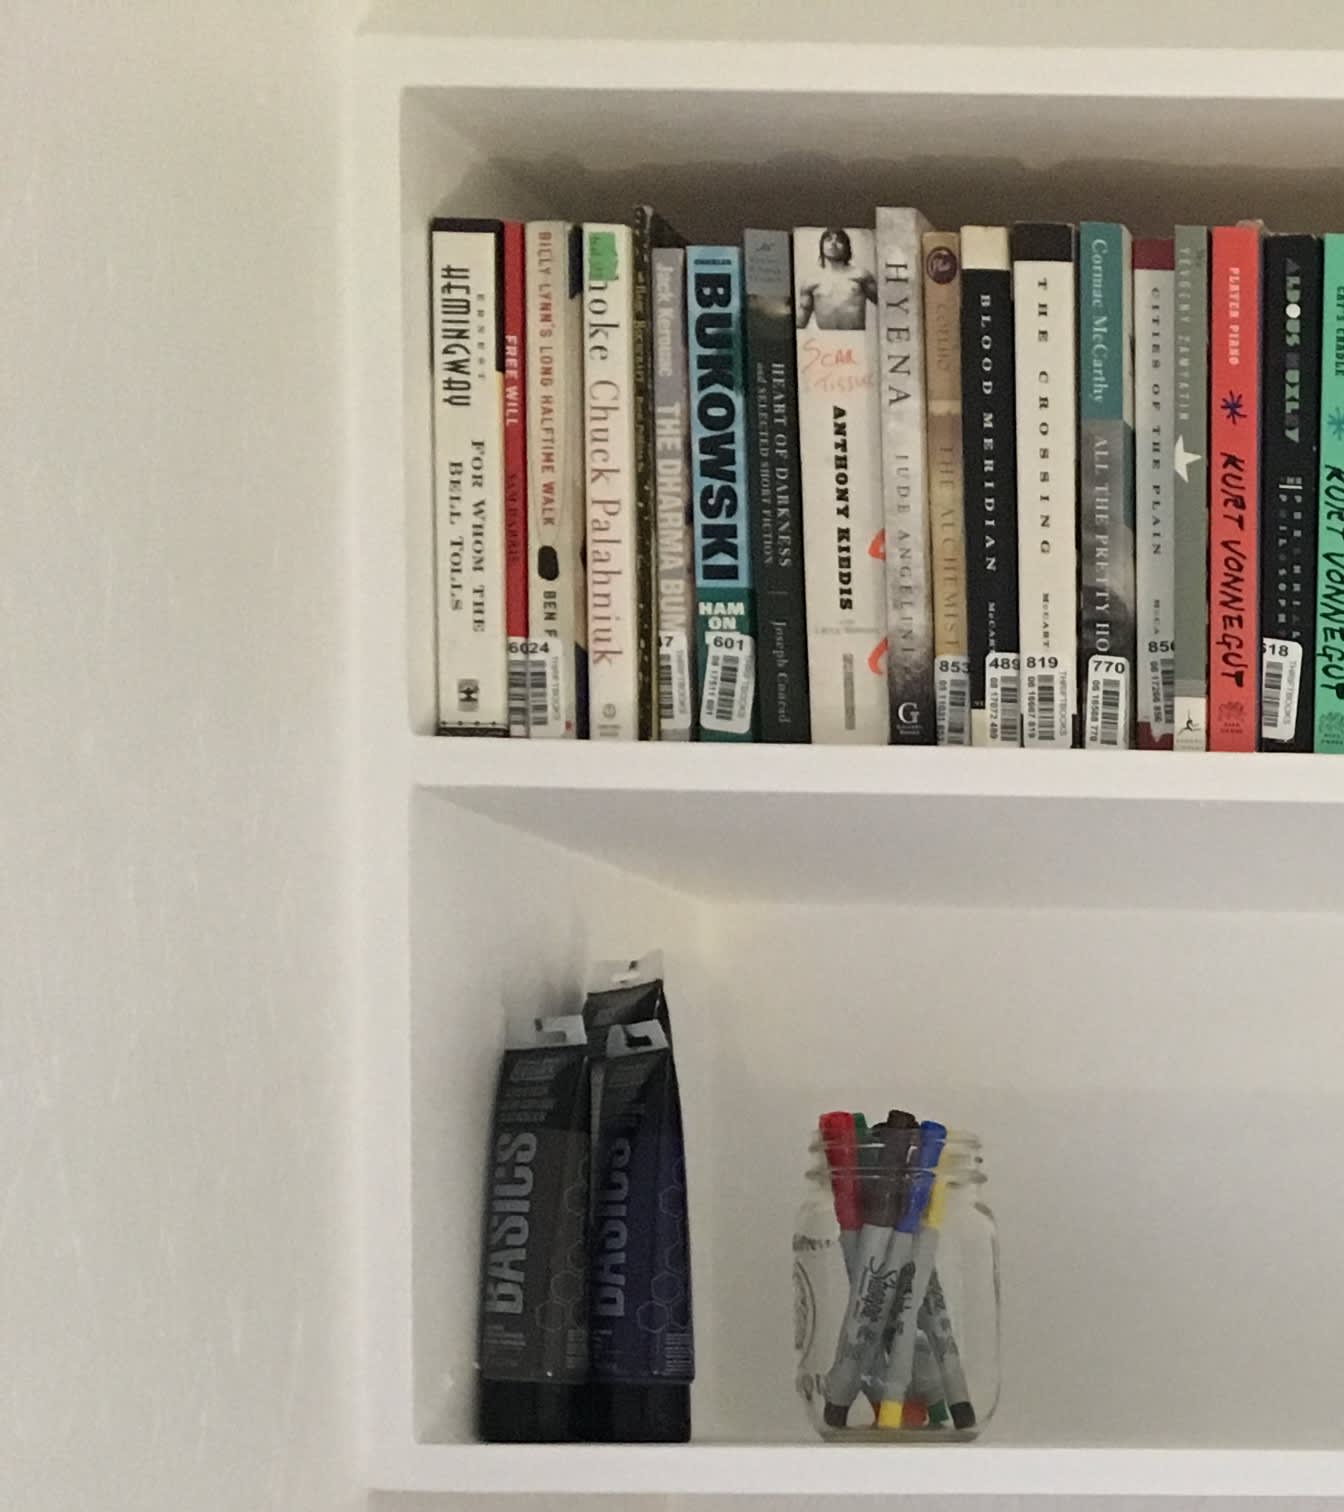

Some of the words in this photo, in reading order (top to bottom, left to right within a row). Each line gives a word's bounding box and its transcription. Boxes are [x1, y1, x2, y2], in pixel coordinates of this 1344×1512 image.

[538, 231, 553, 275] BILLY
[656, 263, 674, 304] Jack
[1092, 238, 1108, 308] Cormac
[538, 283, 555, 337] LYNN'S
[1037, 277, 1048, 343] THE
[1177, 247, 1191, 324] YEVGENY
[1228, 267, 1240, 317] PLAYER
[441, 265, 471, 407] HEMINGWAY
[477, 294, 486, 379] ERNEST
[504, 335, 517, 379] FREE
[657, 308, 674, 377] Kerouac
[885, 262, 912, 408] HYENA
[980, 294, 993, 395] BLOOD
[1092, 315, 1109, 403] McCarthy
[1151, 287, 1161, 369] CITIES
[1228, 325, 1240, 366] PIANO
[539, 345, 554, 391] LONG
[772, 363, 787, 426] HEART
[1151, 383, 1161, 411] OF
[1178, 335, 1191, 422] ZAMYATIN
[505, 385, 521, 426] WILL
[540, 394, 555, 474] HALFTIME
[589, 380, 620, 484] Chuck
[656, 402, 682, 453] THE
[694, 273, 739, 580] BUKOWSKI
[757, 388, 769, 458] SELECTED
[471, 440, 485, 488] FOR
[773, 432, 788, 458] OF
[832, 405, 850, 519] ANTHONY
[940, 447, 953, 485] THE
[1038, 370, 1051, 555] CROSSING
[1095, 435, 1109, 476] ALL
[1151, 425, 1161, 470] THE
[449, 462, 464, 525] BELL
[541, 481, 555, 526] WALK
[759, 465, 771, 505] SHORT
[895, 455, 912, 514] JUDE
[982, 412, 997, 572] MERIDIAN
[1096, 484, 1109, 526] THE
[1220, 452, 1247, 532] KURT
[472, 500, 486, 573] WHOM
[657, 460, 686, 575] DHARMA
[761, 510, 774, 564] FICTION
[775, 467, 792, 568] DARKNESS
[1152, 483, 1162, 555] PLAIN
[450, 536, 464, 611] TOLLS
[591, 500, 624, 666] Palahniuk
[837, 527, 853, 611] KIEDIS
[897, 529, 915, 655] ANGELINI
[940, 508, 959, 649] ALCHEMIST
[1095, 534, 1110, 614] PRETTY
[472, 585, 486, 633] THE
[543, 590, 558, 621] BEN
[699, 602, 745, 615] HAM
[708, 616, 737, 630] ON
[1215, 539, 1249, 689] VONNEGUT
[713, 636, 744, 651] 601
[772, 619, 789, 668] Joseph
[989, 656, 1020, 671] 489
[1026, 656, 1058, 669] 819
[1093, 659, 1126, 674] 770
[777, 673, 792, 723] Conrad
[485, 1130, 538, 1316] BASICS
